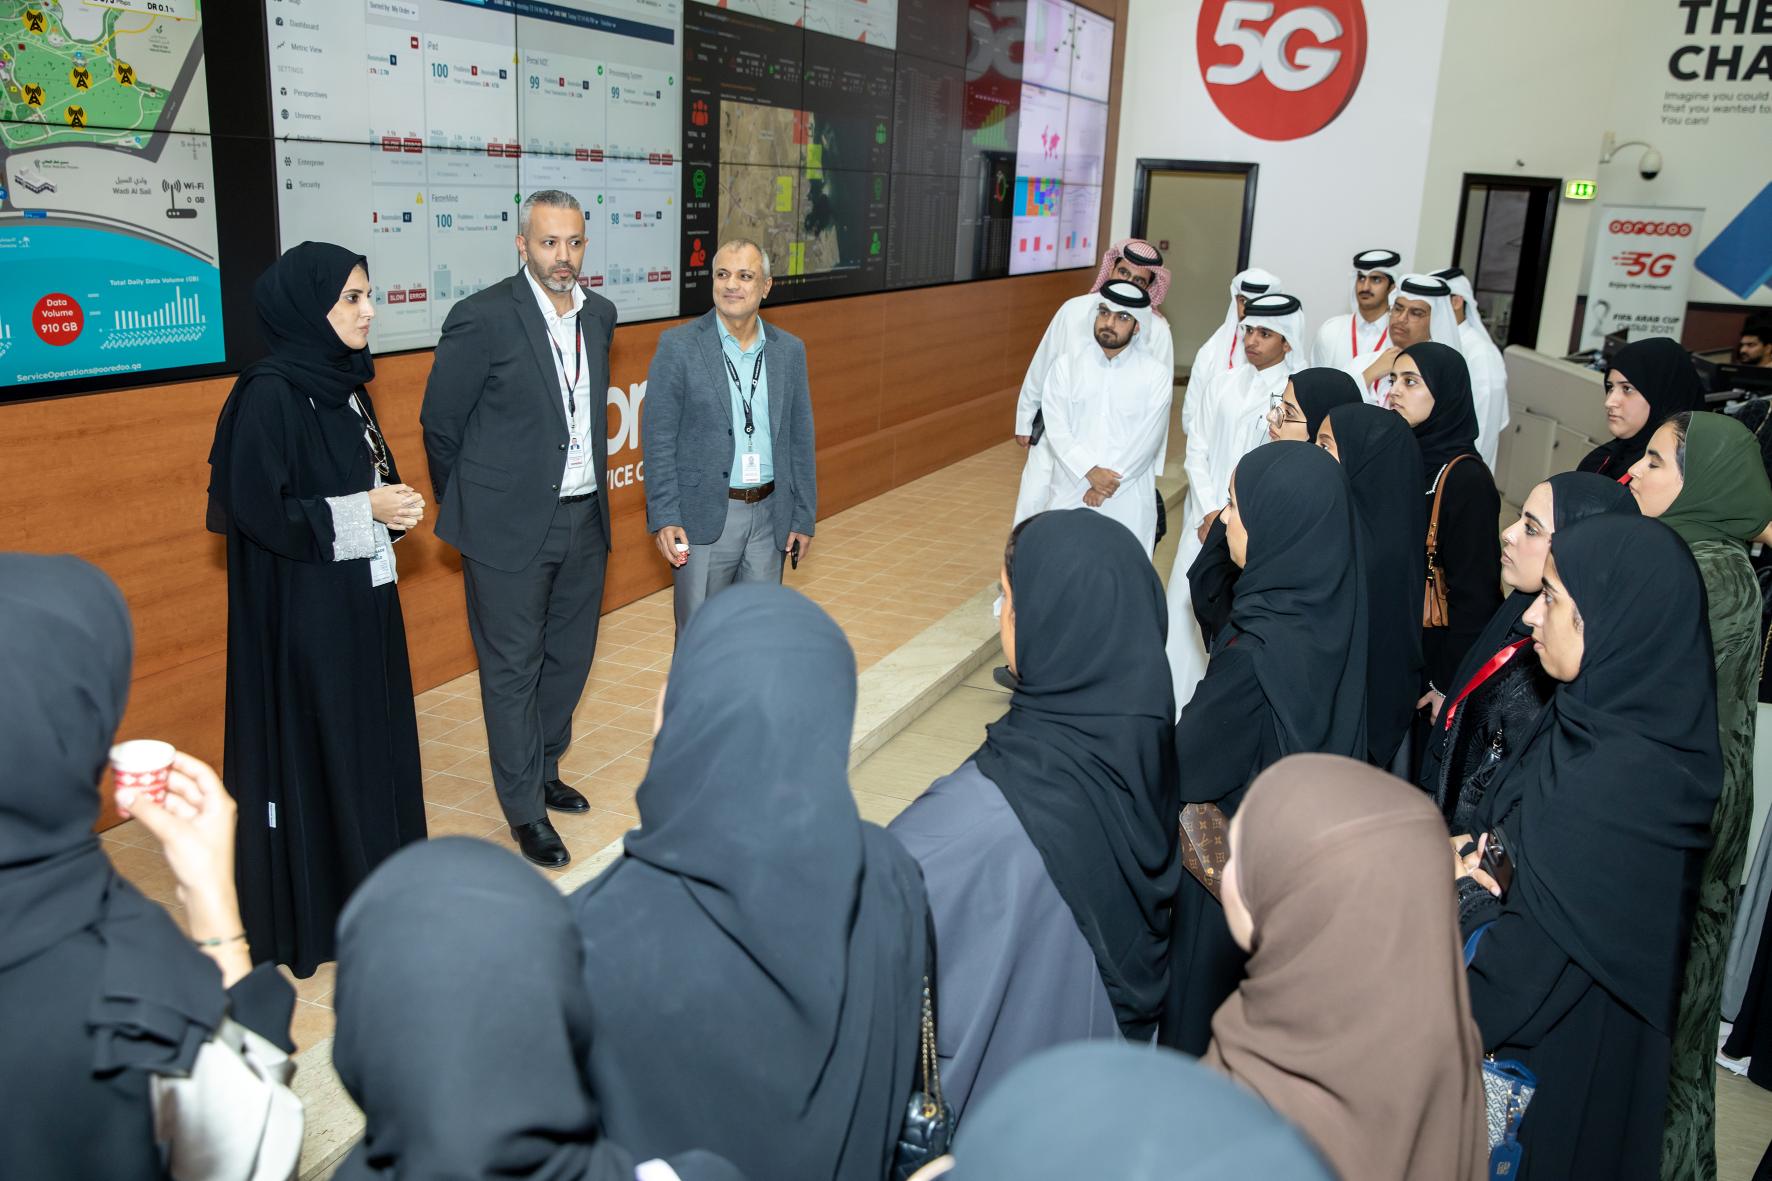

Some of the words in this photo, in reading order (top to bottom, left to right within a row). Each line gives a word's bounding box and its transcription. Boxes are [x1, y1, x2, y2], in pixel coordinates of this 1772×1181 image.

[1679, 0, 1772, 35] THE
[289, 19, 319, 31] Dashboard
[291, 43, 308, 52] Metric
[309, 45, 323, 54] View
[1206, 0, 1344, 91] 5G
[1668, 45, 1772, 82] CHA
[277, 65, 304, 75] SETTINGS
[432, 63, 448, 78] 100
[530, 75, 540, 89] 99
[293, 88, 328, 99] Perspectives
[611, 86, 620, 99] 99
[1664, 91, 1710, 103] Imagine
[1713, 93, 1734, 102] you
[1736, 91, 1770, 101] could
[1662, 103, 1686, 113] that
[1689, 105, 1710, 114] you
[1713, 104, 1756, 113] wanted
[295, 112, 321, 121] Universes
[1661, 116, 1681, 125] You
[298, 158, 325, 167] Enterprise
[183, 182, 205, 190] Wi-Fi
[299, 181, 321, 190] Security
[436, 214, 452, 228] 100
[611, 212, 620, 225] 98
[1609, 220, 1692, 237] ooredoo
[1623, 252, 1677, 278] 5G
[1609, 281, 1628, 290] Enjoy
[47, 299, 68, 307] Data
[42, 309, 73, 318] Volume
[1613, 313, 1633, 321] FIFA
[1635, 315, 1660, 323] ARAB
[1662, 316, 1680, 324] CUP
[41, 323, 60, 334] 910
[62, 321, 78, 332] GB
[1650, 324, 1675, 334] 2021
[16, 363, 142, 381] ServiceOperations@ooredoo.qa
